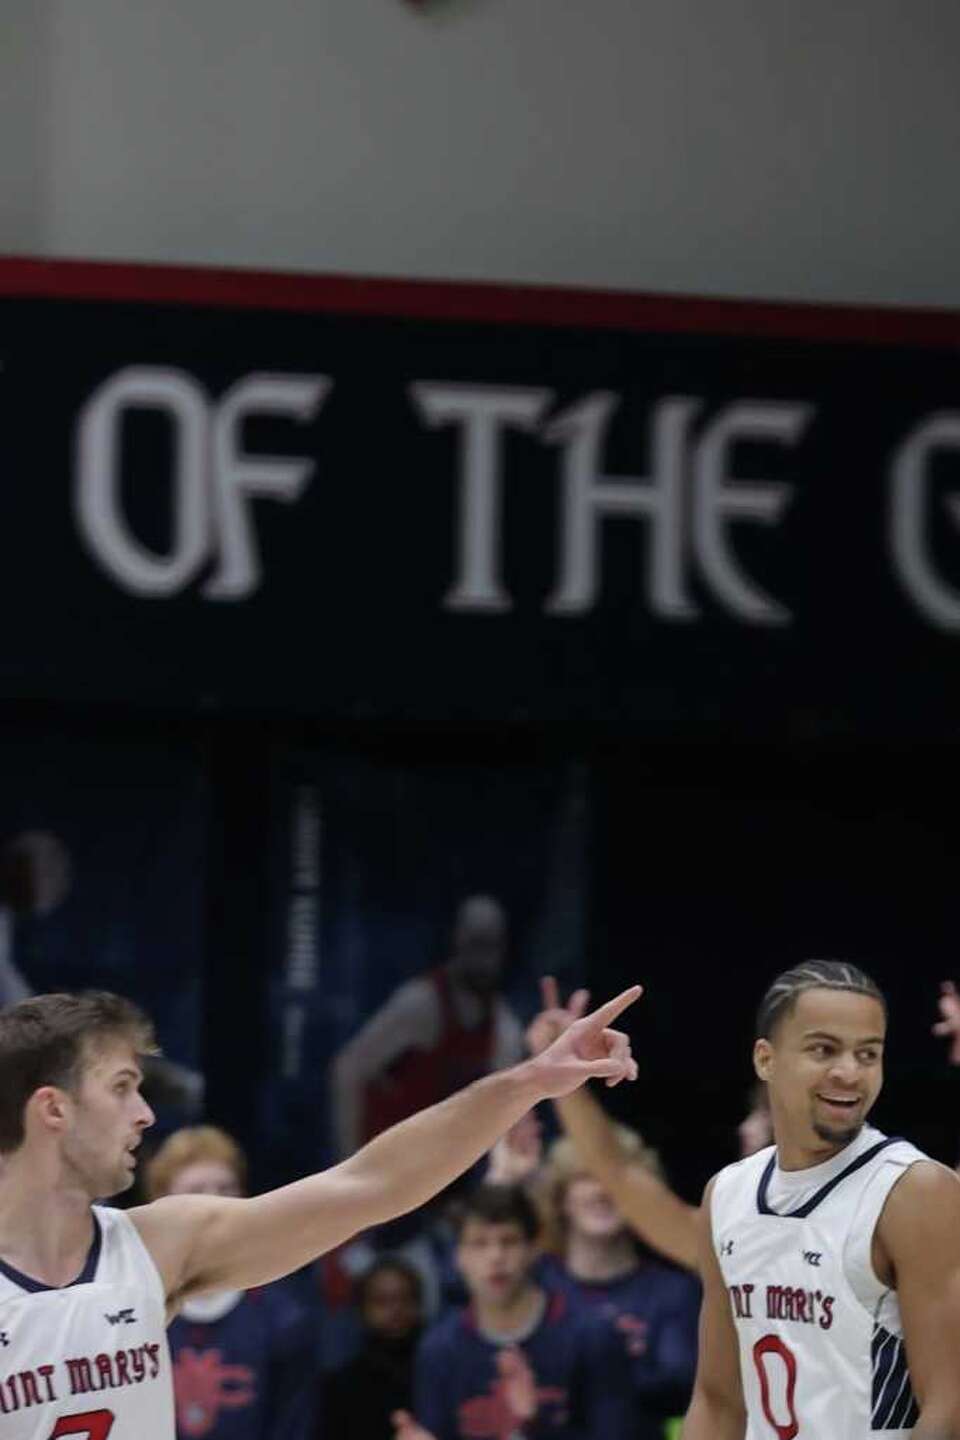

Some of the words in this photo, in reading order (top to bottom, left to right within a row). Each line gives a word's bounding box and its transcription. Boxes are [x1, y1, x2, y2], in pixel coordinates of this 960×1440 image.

[74, 363, 333, 602] OF
[406, 378, 815, 627] THE
[64, 1342, 160, 1395] MARY'S
